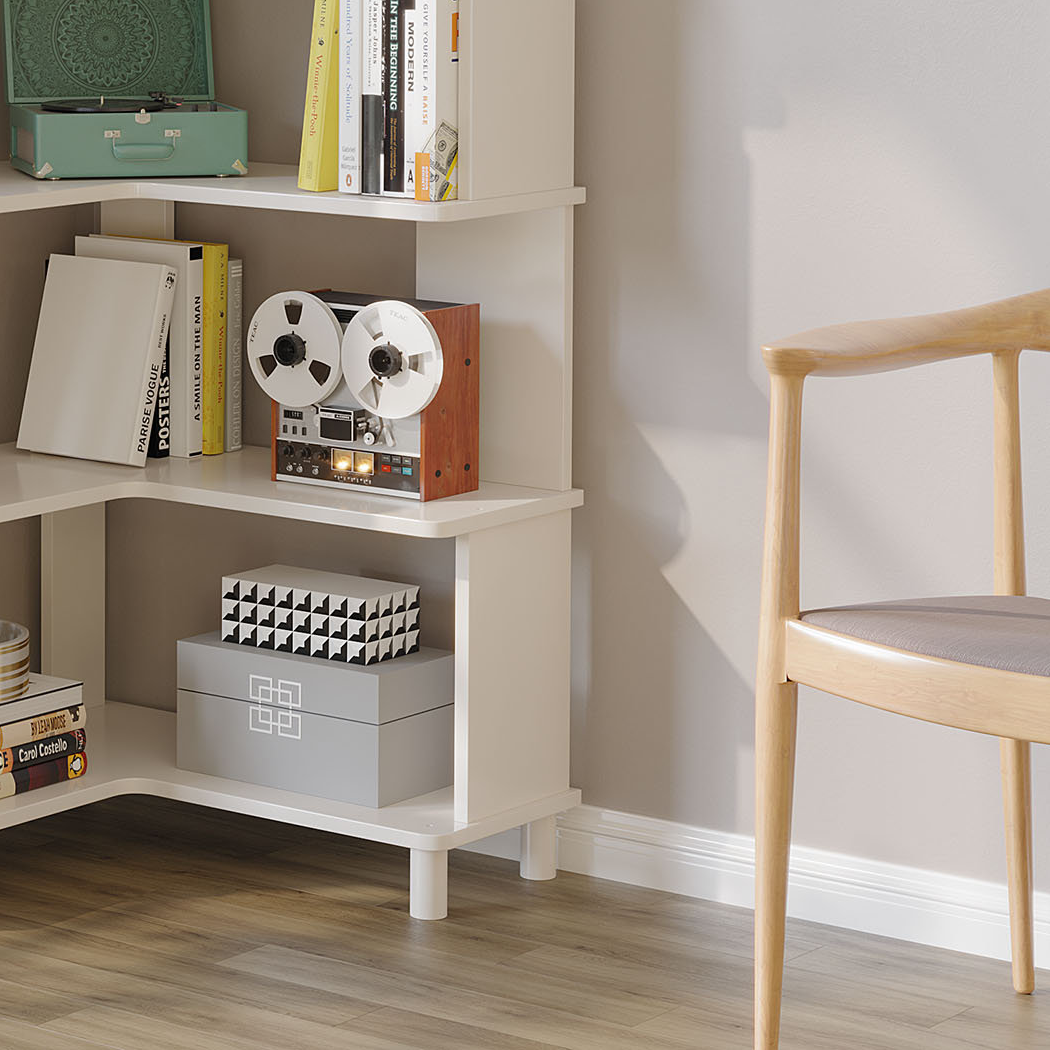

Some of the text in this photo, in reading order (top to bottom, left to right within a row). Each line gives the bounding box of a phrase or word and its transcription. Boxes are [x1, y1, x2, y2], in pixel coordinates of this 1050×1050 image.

[318, 0, 327, 28] MILNE
[345, 38, 353, 64] Years
[406, 22, 415, 92] MODERN
[422, 31, 430, 82] YOURSELF
[345, 67, 353, 79] of
[389, 43, 399, 111] BEGINNING
[310, 54, 323, 136] Winnie-the-Pooh
[345, 83, 353, 124] Solitude
[389, 309, 408, 322] TEAC
[249, 320, 259, 343] TEAC
[194, 354, 201, 370] ON
[231, 338, 241, 377] DESIGN
[231, 380, 241, 398] ON
[138, 364, 159, 452] PARISE VOGUE
[157, 376, 171, 450] POSTERS
[194, 413, 201, 421] A
[19, 744, 38, 763] Carol
[39, 738, 68, 757] Costello
